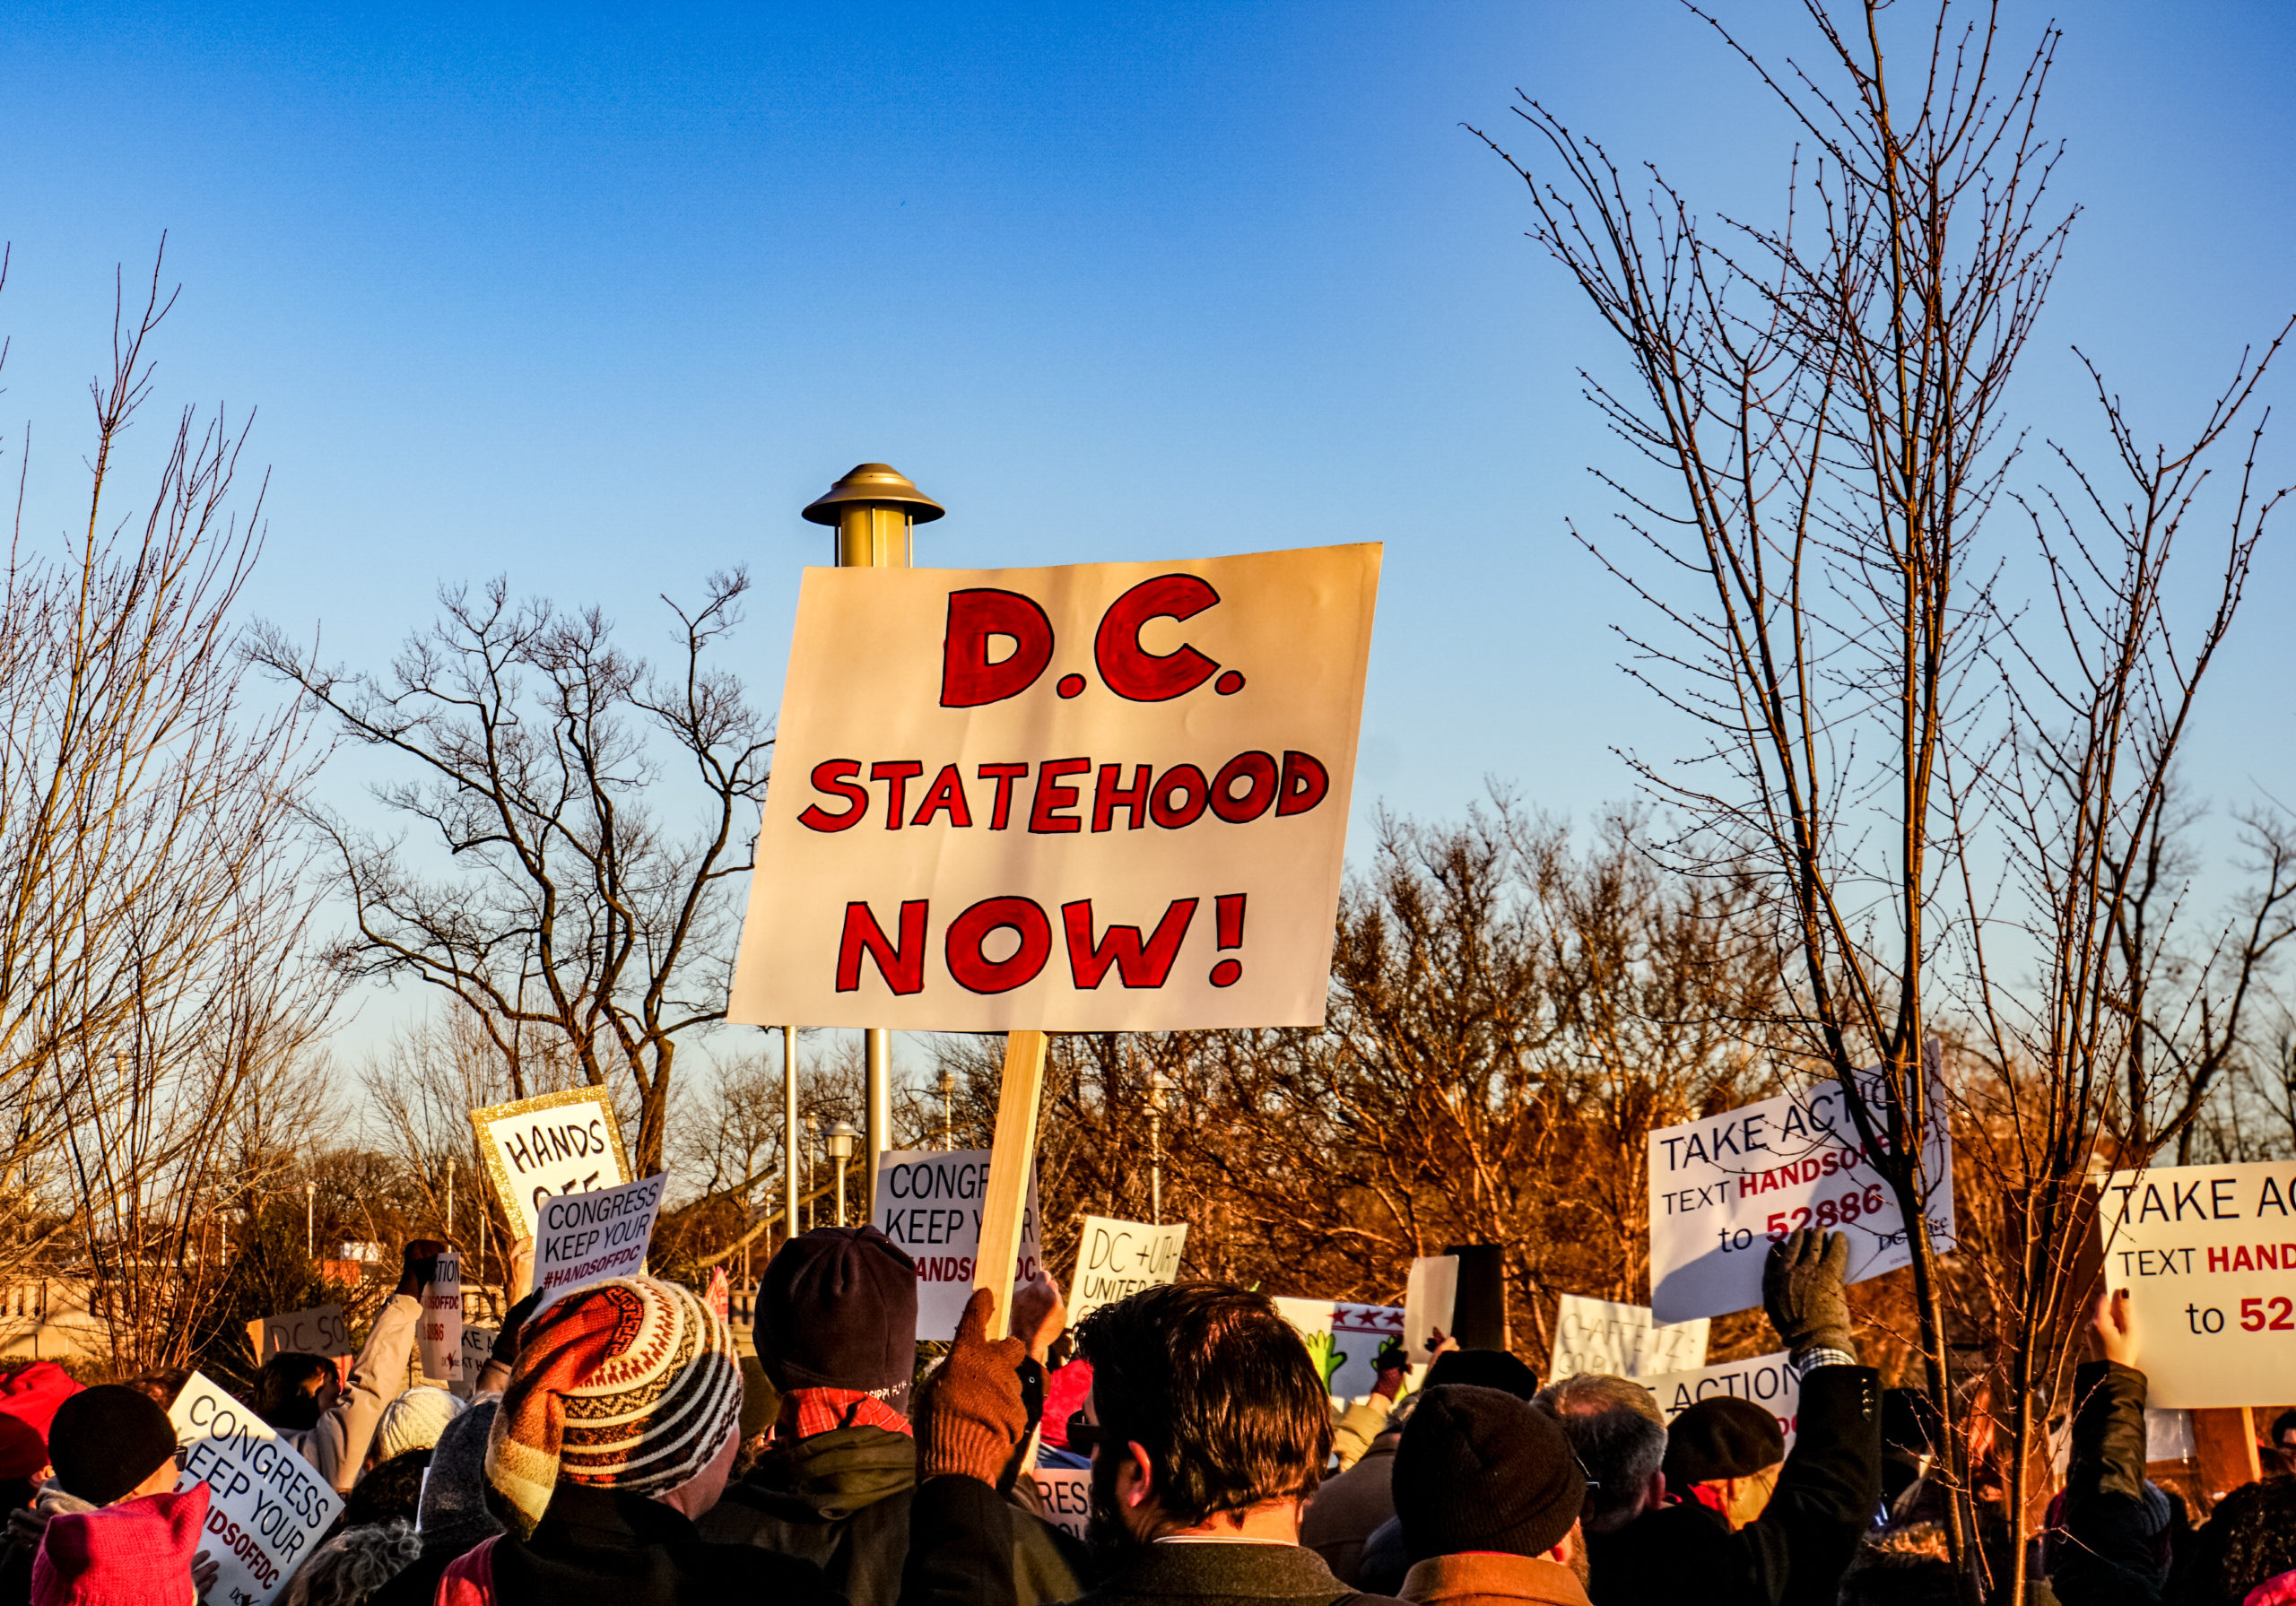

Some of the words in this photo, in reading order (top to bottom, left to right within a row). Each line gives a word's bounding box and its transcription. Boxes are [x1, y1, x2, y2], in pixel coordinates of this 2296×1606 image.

[940, 573, 1246, 708] D.C.
[797, 750, 1329, 834] STATEHOOD
[835, 893, 1247, 996] NOW!
[504, 1119, 604, 1174] HANDS
[1660, 1114, 1768, 1171] TAKE
[548, 1182, 659, 1230] CONGRESS
[1662, 1181, 1730, 1215] TEXT
[1718, 1227, 1752, 1253] to
[1766, 1184, 1883, 1243] 52886
[2111, 1178, 2239, 1225] TAKE
[544, 1229, 599, 1263] KEEP
[603, 1213, 650, 1252] YOUR
[885, 1208, 964, 1244] KEEP
[1090, 1228, 1133, 1272] DC
[543, 1245, 641, 1289] #HANDSOFFDC
[2117, 1247, 2196, 1277] TEXT
[270, 1323, 312, 1351] DC
[2185, 1303, 2224, 1334] to
[189, 1394, 329, 1528] CONGRESS
[250, 1489, 305, 1564] YOUR
